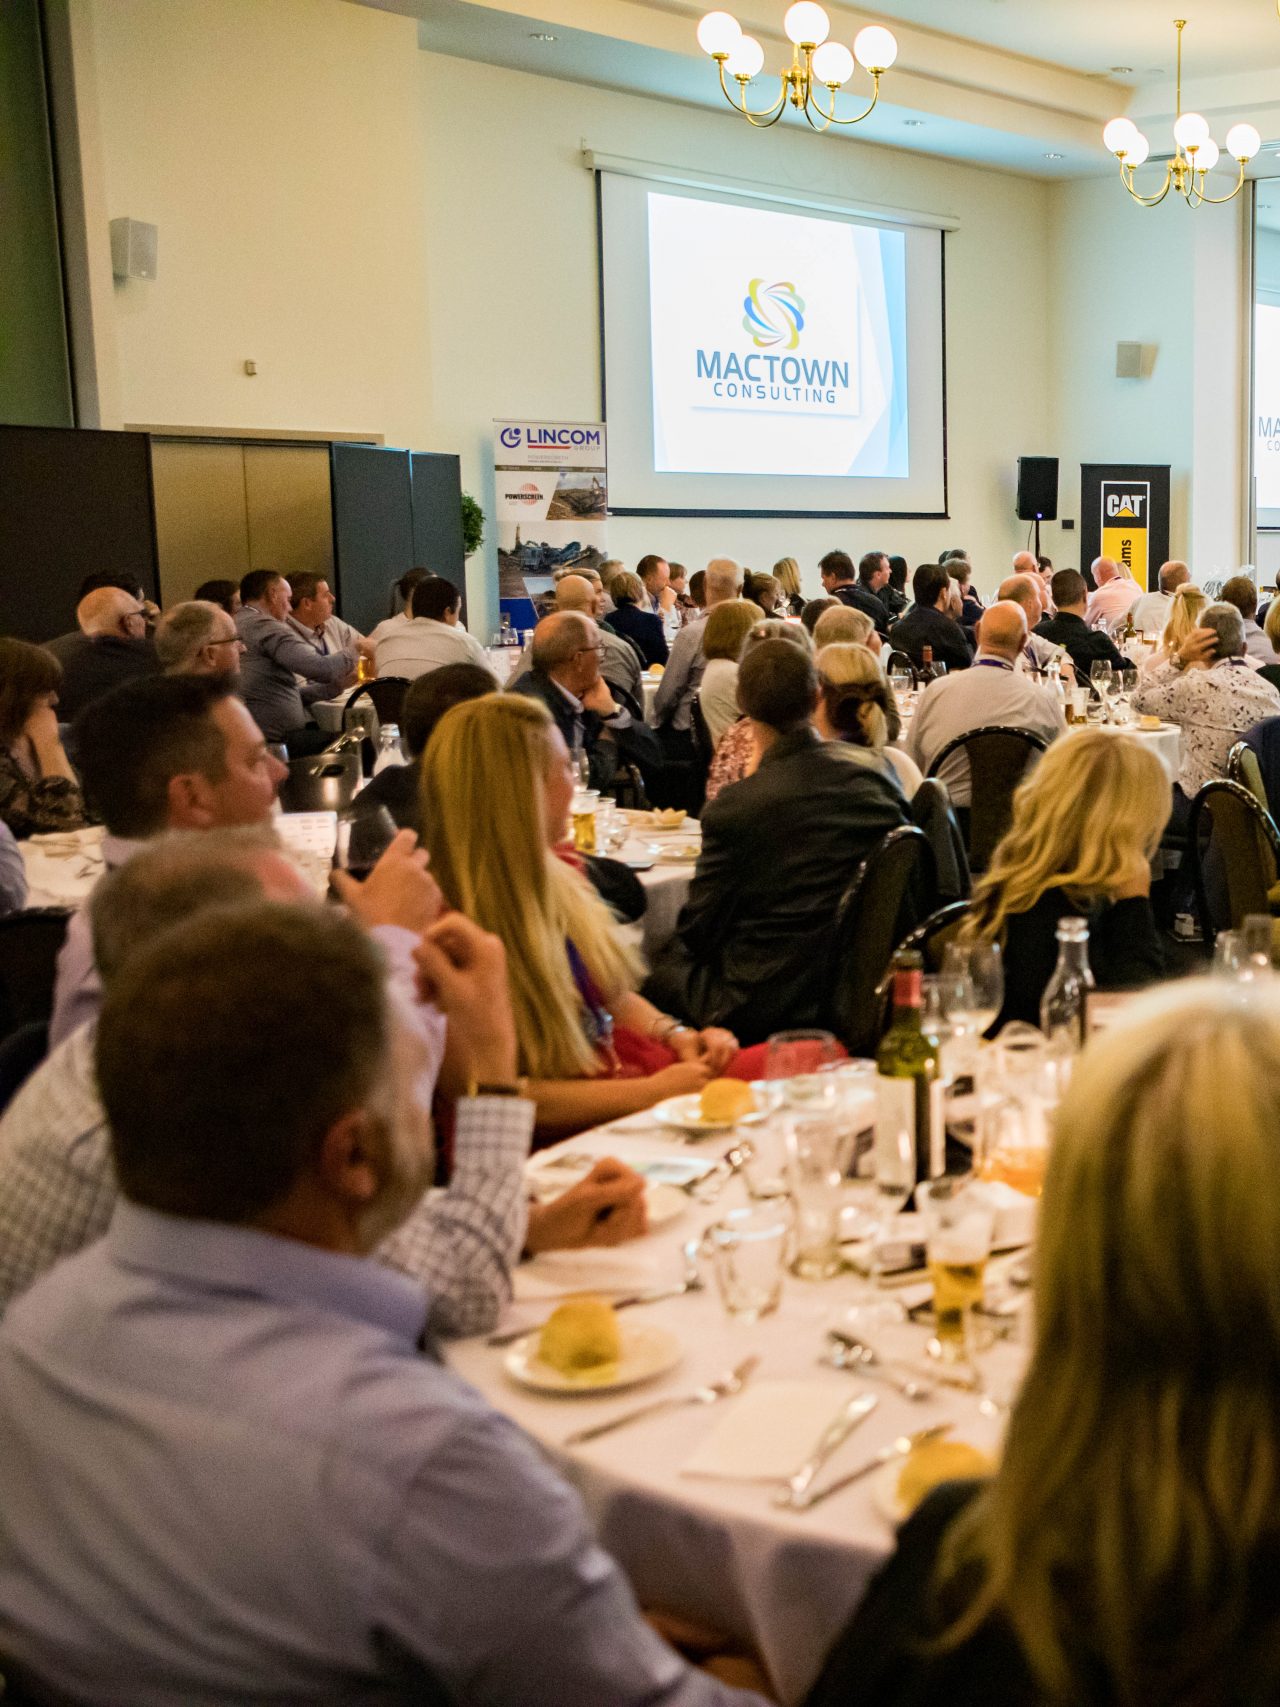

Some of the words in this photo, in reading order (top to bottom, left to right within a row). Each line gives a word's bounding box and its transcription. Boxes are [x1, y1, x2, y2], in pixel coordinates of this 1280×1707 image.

[696, 349, 849, 388] MACTOWN
[713, 382, 836, 404] CONSULTING
[526, 428, 600, 445] LINCOM
[1106, 494, 1143, 518] CAT
[1121, 539, 1132, 568] ams
